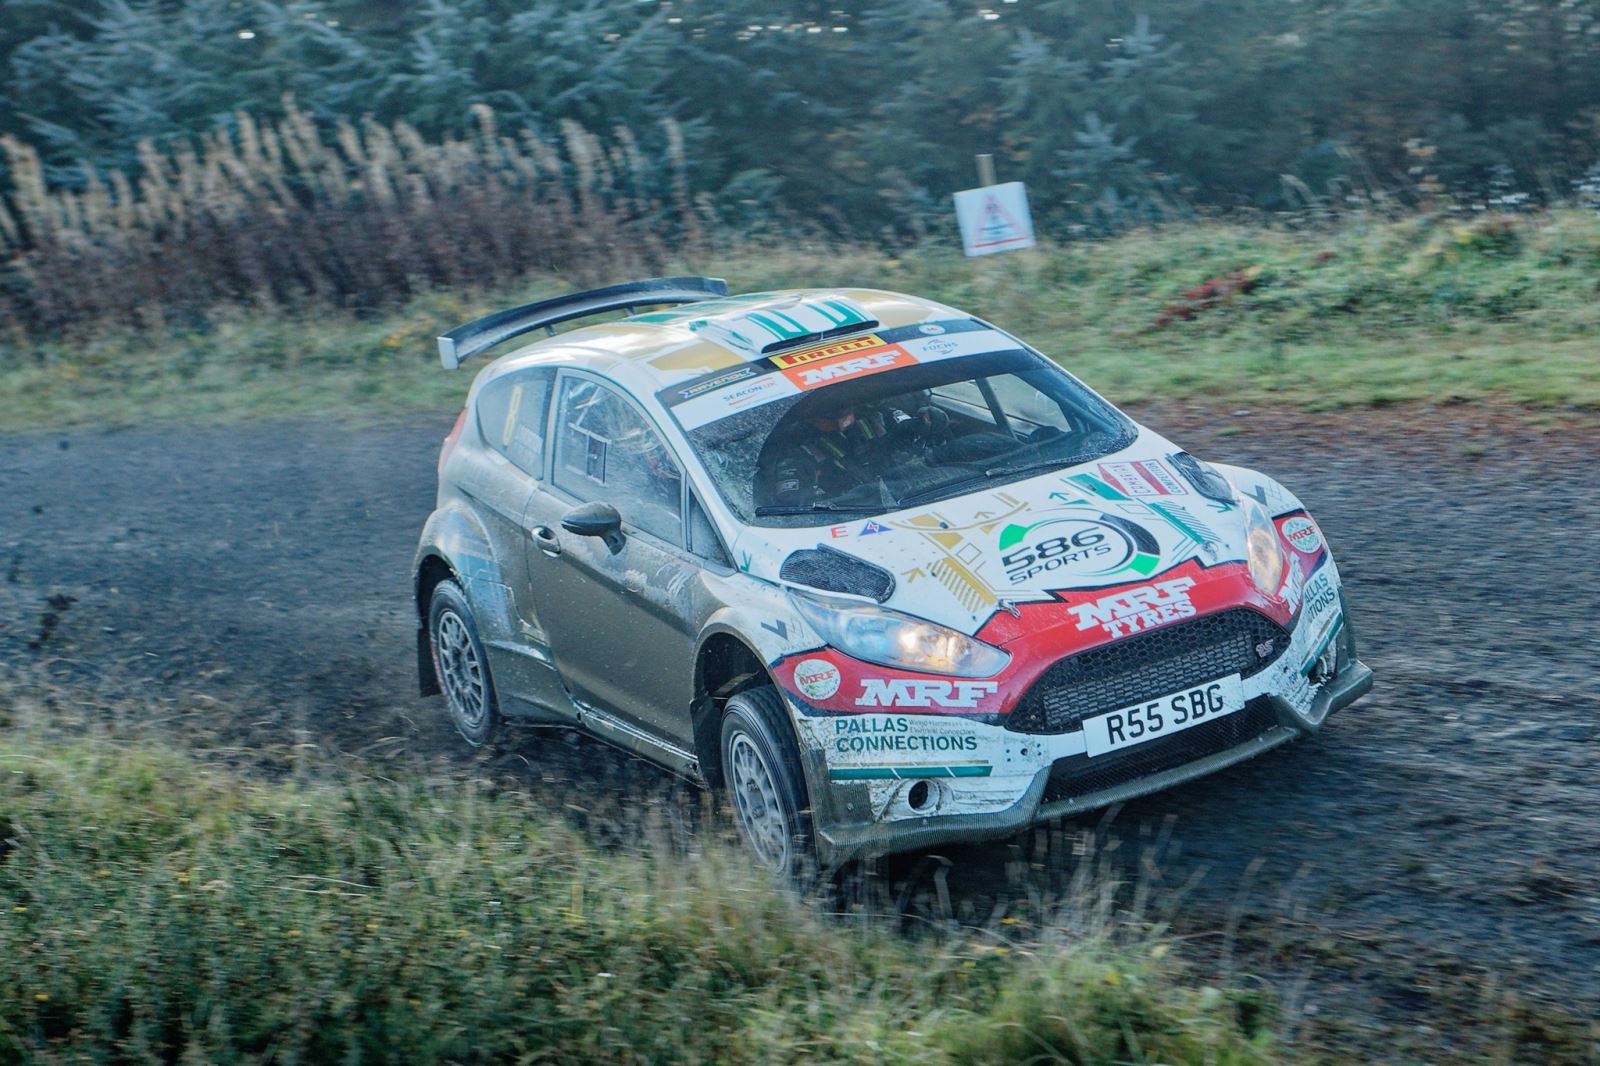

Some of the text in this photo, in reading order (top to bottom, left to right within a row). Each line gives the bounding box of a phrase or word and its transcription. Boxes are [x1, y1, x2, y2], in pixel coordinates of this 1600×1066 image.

[780, 336, 877, 365] PIRELLI
[798, 349, 902, 386] MRF
[723, 386, 763, 401] SEACON
[830, 525, 849, 539] E
[1001, 526, 1105, 574] 586
[1009, 543, 1112, 586] SPORTS
[1067, 576, 1197, 632] MRF
[1101, 599, 1197, 639] TYRES
[855, 679, 998, 708] MRF
[835, 718, 909, 735] PALLAS
[1107, 683, 1224, 745] R55 SBG
[837, 735, 978, 753] CONNECTIONS
